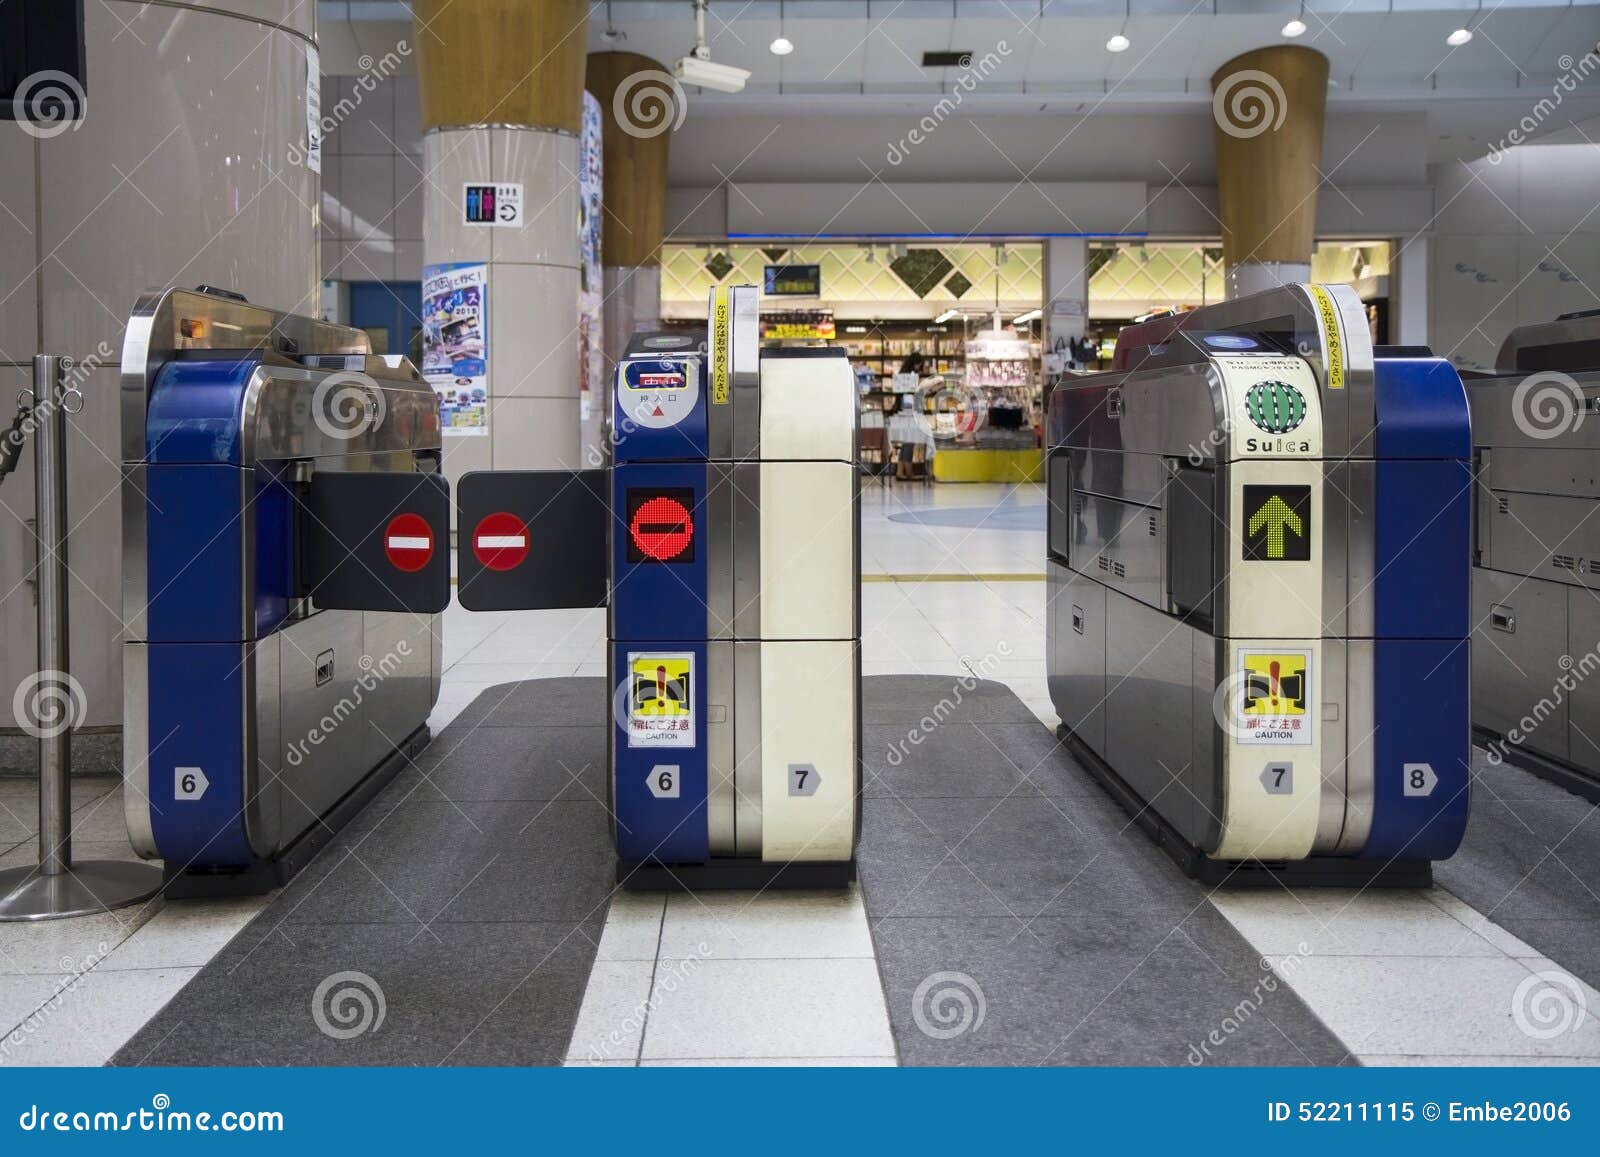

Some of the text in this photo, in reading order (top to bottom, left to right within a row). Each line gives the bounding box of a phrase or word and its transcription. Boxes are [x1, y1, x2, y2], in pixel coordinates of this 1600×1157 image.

[1246, 438, 1309, 452] Suica
[633, 719, 689, 731] 扉にご注意
[1246, 718, 1302, 730] 扉にご注意
[645, 732, 678, 740] CAUTION
[1255, 731, 1293, 739] CAUTION
[182, 774, 196, 793] 6
[658, 772, 672, 791] 6
[795, 770, 808, 789] 7
[1272, 768, 1286, 787] 7
[1410, 769, 1424, 788] 8
